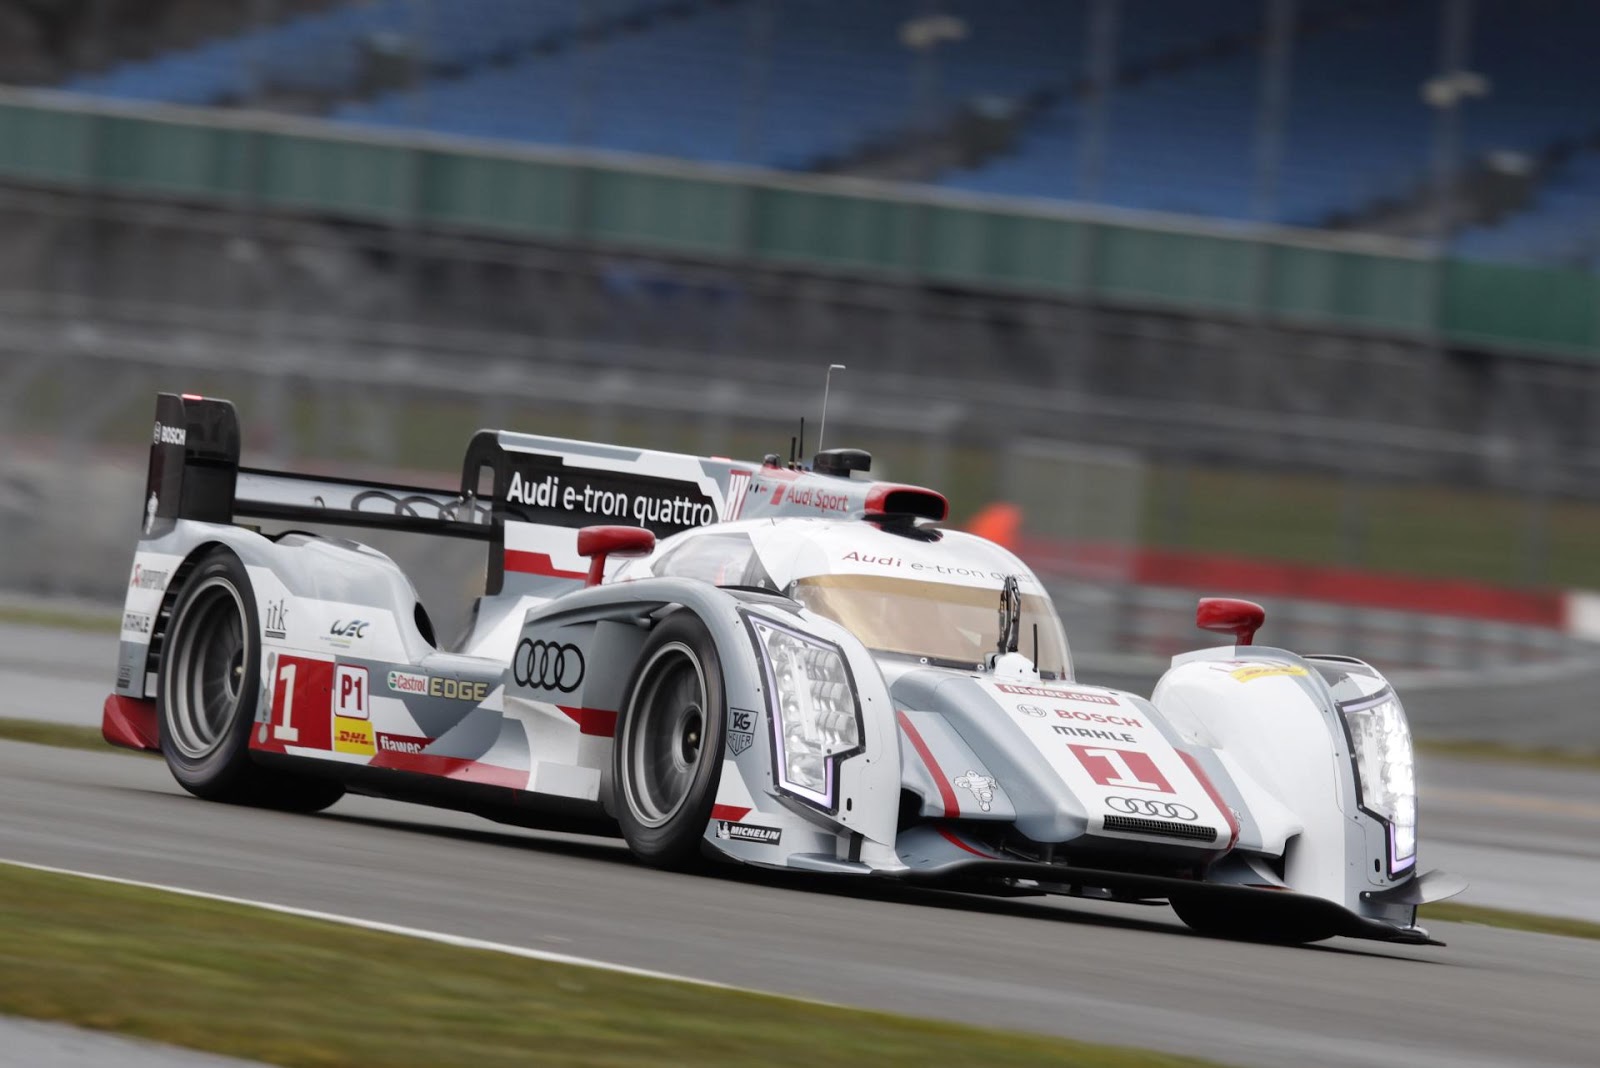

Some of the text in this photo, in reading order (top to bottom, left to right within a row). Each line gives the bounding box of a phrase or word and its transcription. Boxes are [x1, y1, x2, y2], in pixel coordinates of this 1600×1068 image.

[161, 425, 186, 446] BOSCH
[506, 471, 713, 528] Audi e-tron quattro
[785, 487, 850, 513] Audi Sport
[842, 551, 902, 568] Audi
[911, 562, 985, 580] e-tron
[266, 600, 288, 630] itk
[330, 620, 370, 639] WEC
[341, 674, 363, 710] P1
[397, 675, 488, 701] Castrol EDGE
[1004, 685, 1112, 704] fiawec.com
[274, 664, 299, 742] 1
[1054, 709, 1143, 728] BOSCH
[340, 730, 368, 745] DHL
[729, 733, 751, 752] HEUER
[1052, 725, 1138, 743] MAHLE
[1084, 749, 1161, 791] 1
[730, 825, 780, 840] MICHELIN
